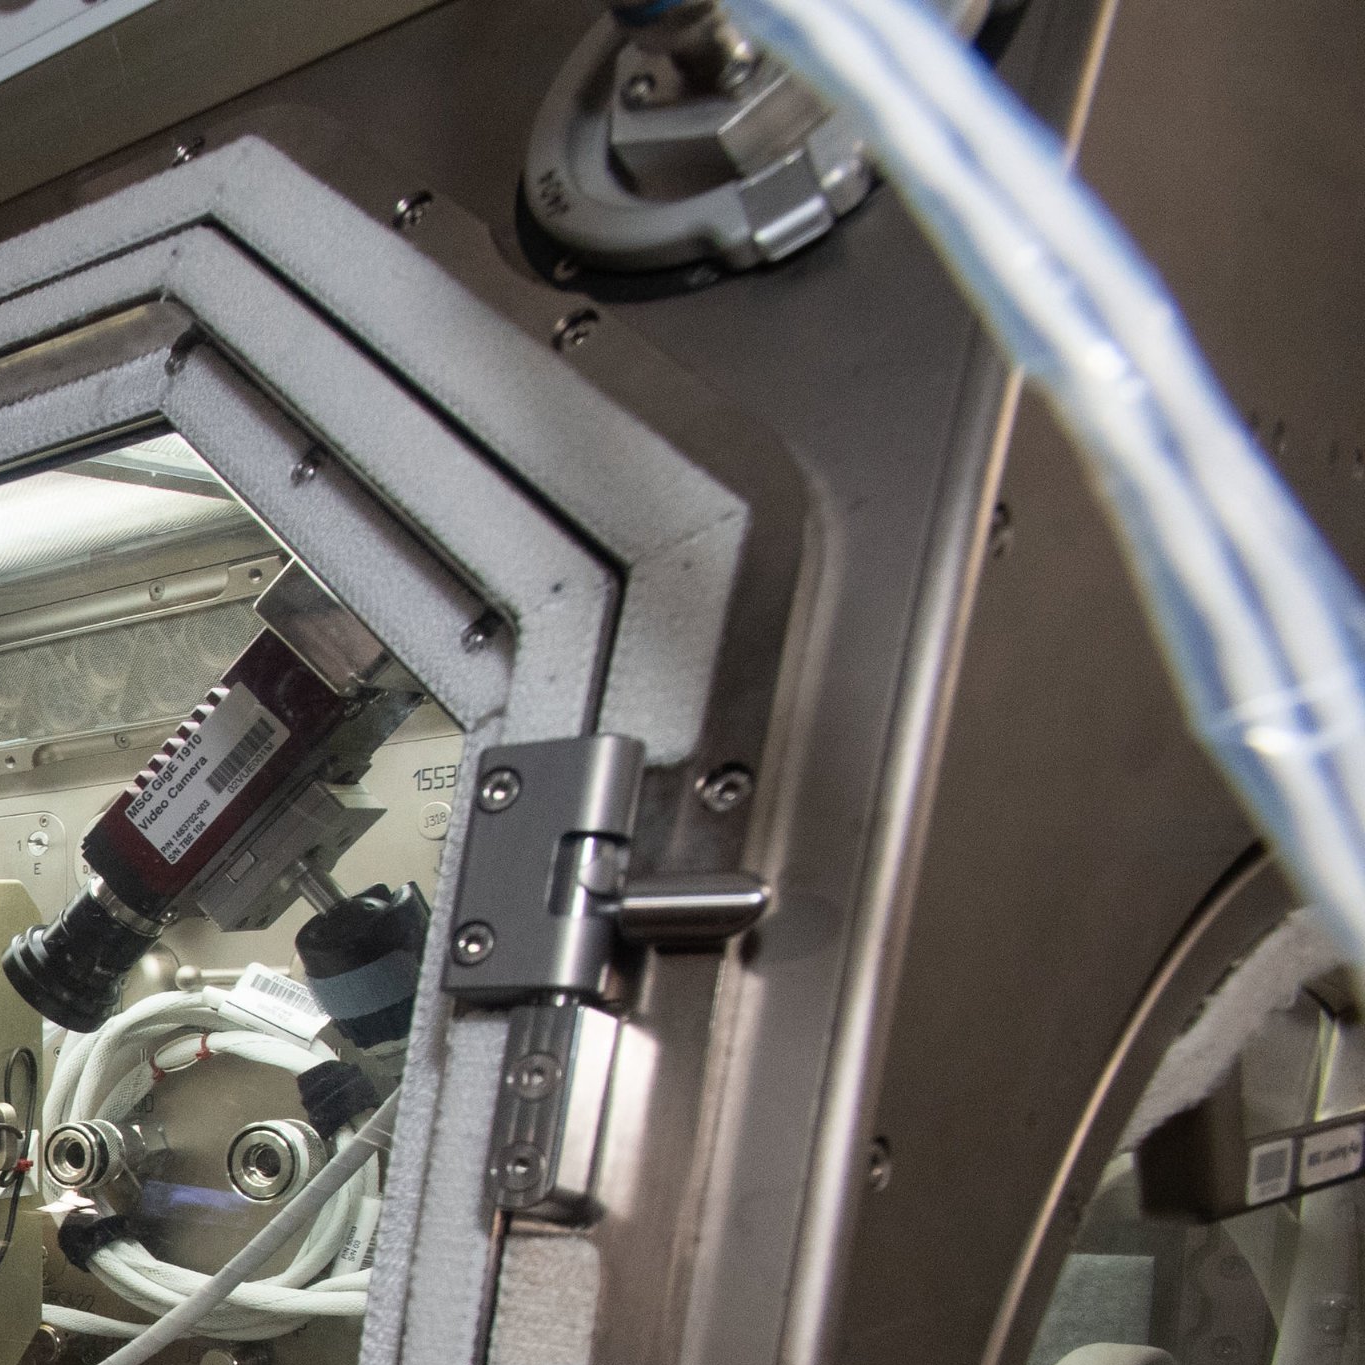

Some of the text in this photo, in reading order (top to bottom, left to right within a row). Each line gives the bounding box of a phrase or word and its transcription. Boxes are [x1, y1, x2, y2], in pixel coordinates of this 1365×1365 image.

[126, 733, 203, 821] MSG GigE 1910
[412, 764, 462, 792] 1553
[138, 755, 209, 831] Video Camera
[423, 811, 447, 829] J318
[16, 840, 22, 852] 1
[160, 838, 175, 854] P/N
[167, 820, 207, 863] S/N TBE 104
[33, 862, 42, 875] E
